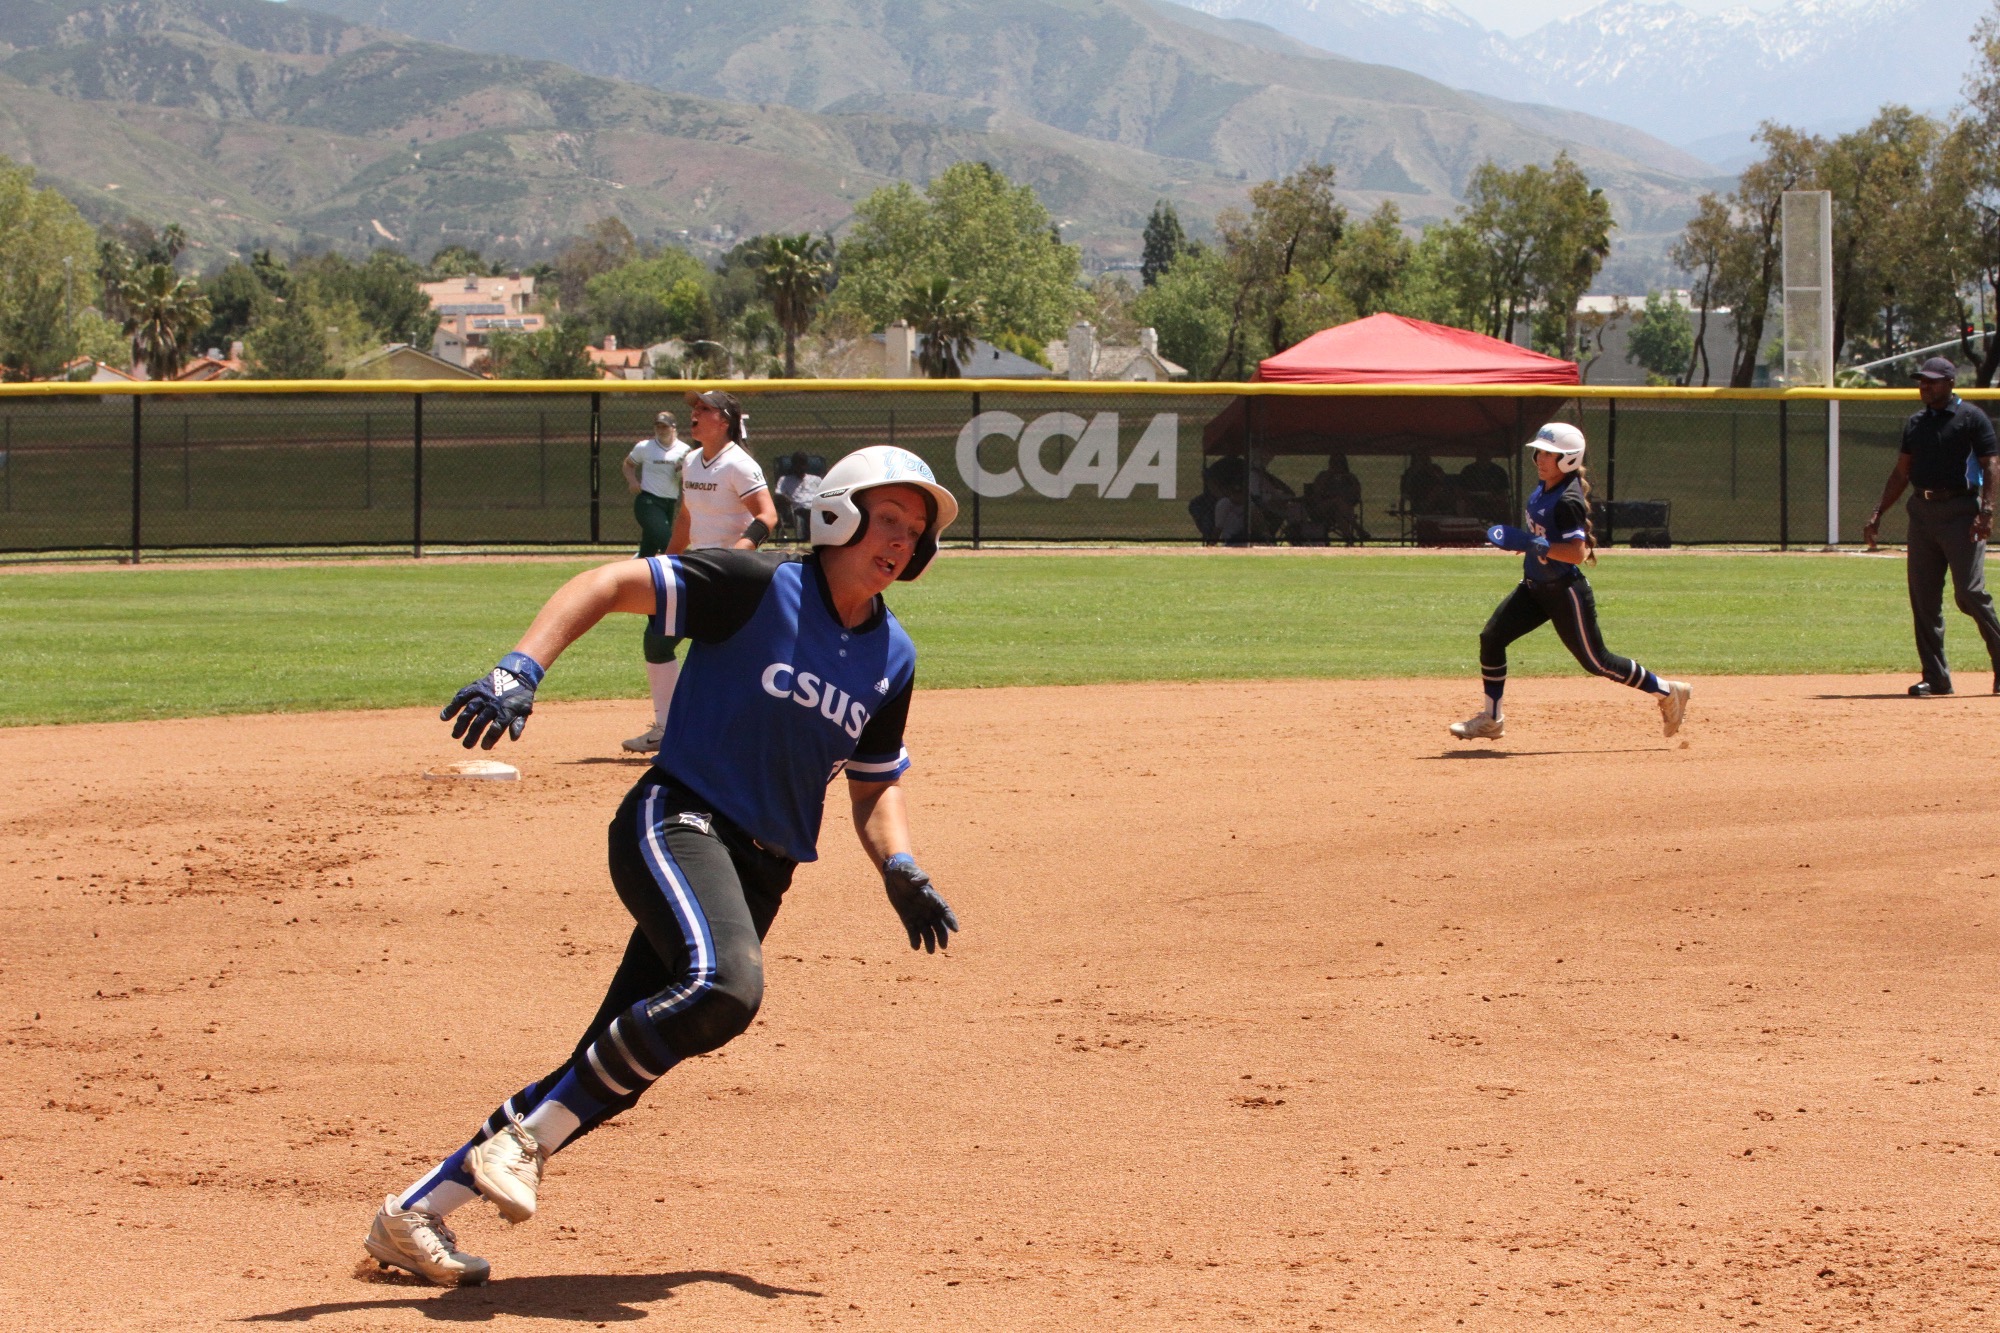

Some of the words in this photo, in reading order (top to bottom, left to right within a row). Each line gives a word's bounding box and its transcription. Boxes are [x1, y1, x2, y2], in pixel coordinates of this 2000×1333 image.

[684, 480, 718, 491] UMBOLDT
[955, 410, 1178, 499] CCAA
[761, 662, 871, 743] CSUS
